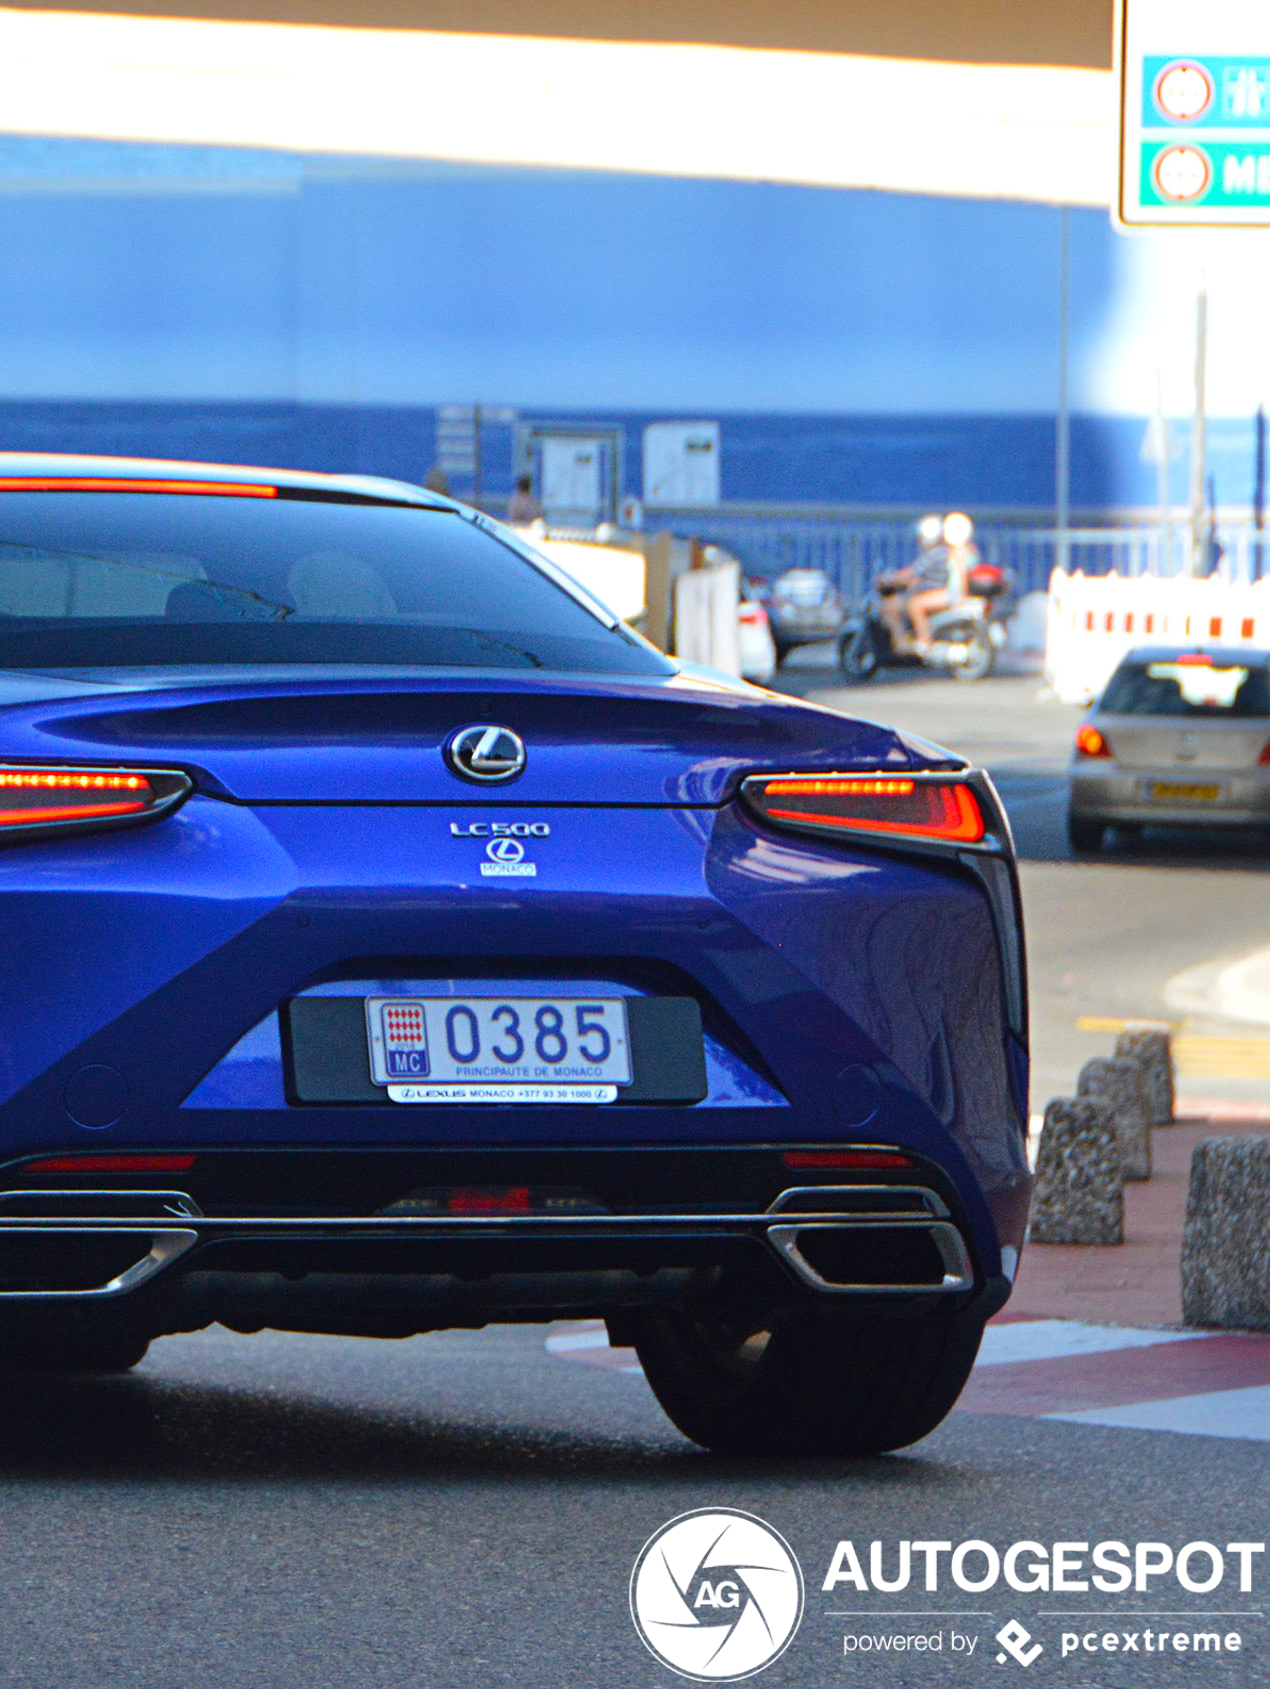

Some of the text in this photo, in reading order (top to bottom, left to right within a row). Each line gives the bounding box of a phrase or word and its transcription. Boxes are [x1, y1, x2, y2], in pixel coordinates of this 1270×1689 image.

[445, 1005, 611, 1064] 0385
[395, 1053, 420, 1072] MC
[455, 1066, 603, 1077] PRINCIPAUTE DE MONACO
[416, 1089, 467, 1098] LEXUS
[470, 1089, 515, 1098] MONACO
